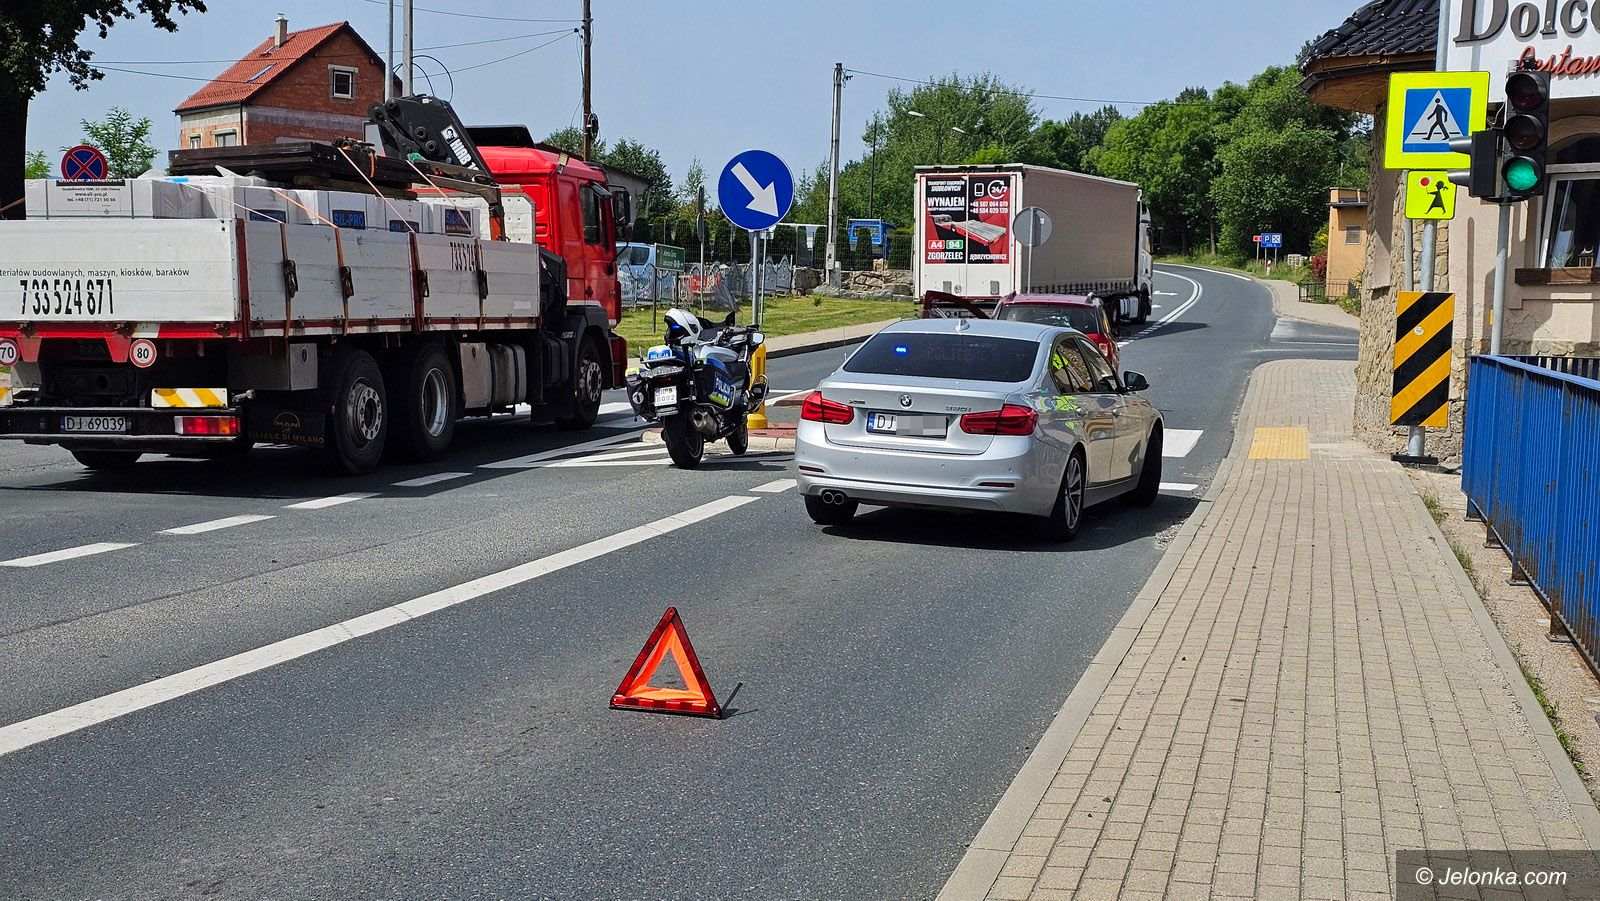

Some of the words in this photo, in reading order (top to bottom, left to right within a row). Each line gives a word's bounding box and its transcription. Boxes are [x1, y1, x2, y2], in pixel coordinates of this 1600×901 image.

[450, 138, 472, 166] HIAB
[927, 196, 965, 207] WYNAJEM
[334, 212, 364, 227] SIL-PRO
[927, 252, 963, 260] ZGORZELEC
[32, 268, 85, 278] budowlanych,
[87, 270, 118, 278] maszyn,
[120, 267, 154, 278] kiosków,
[156, 267, 190, 277] baraków
[1, 347, 14, 358] 70
[136, 347, 149, 359] 80
[66, 417, 82, 430] DJ
[87, 417, 125, 430] 69039
[275, 420, 298, 428] MAN
[877, 414, 894, 430] DJ
